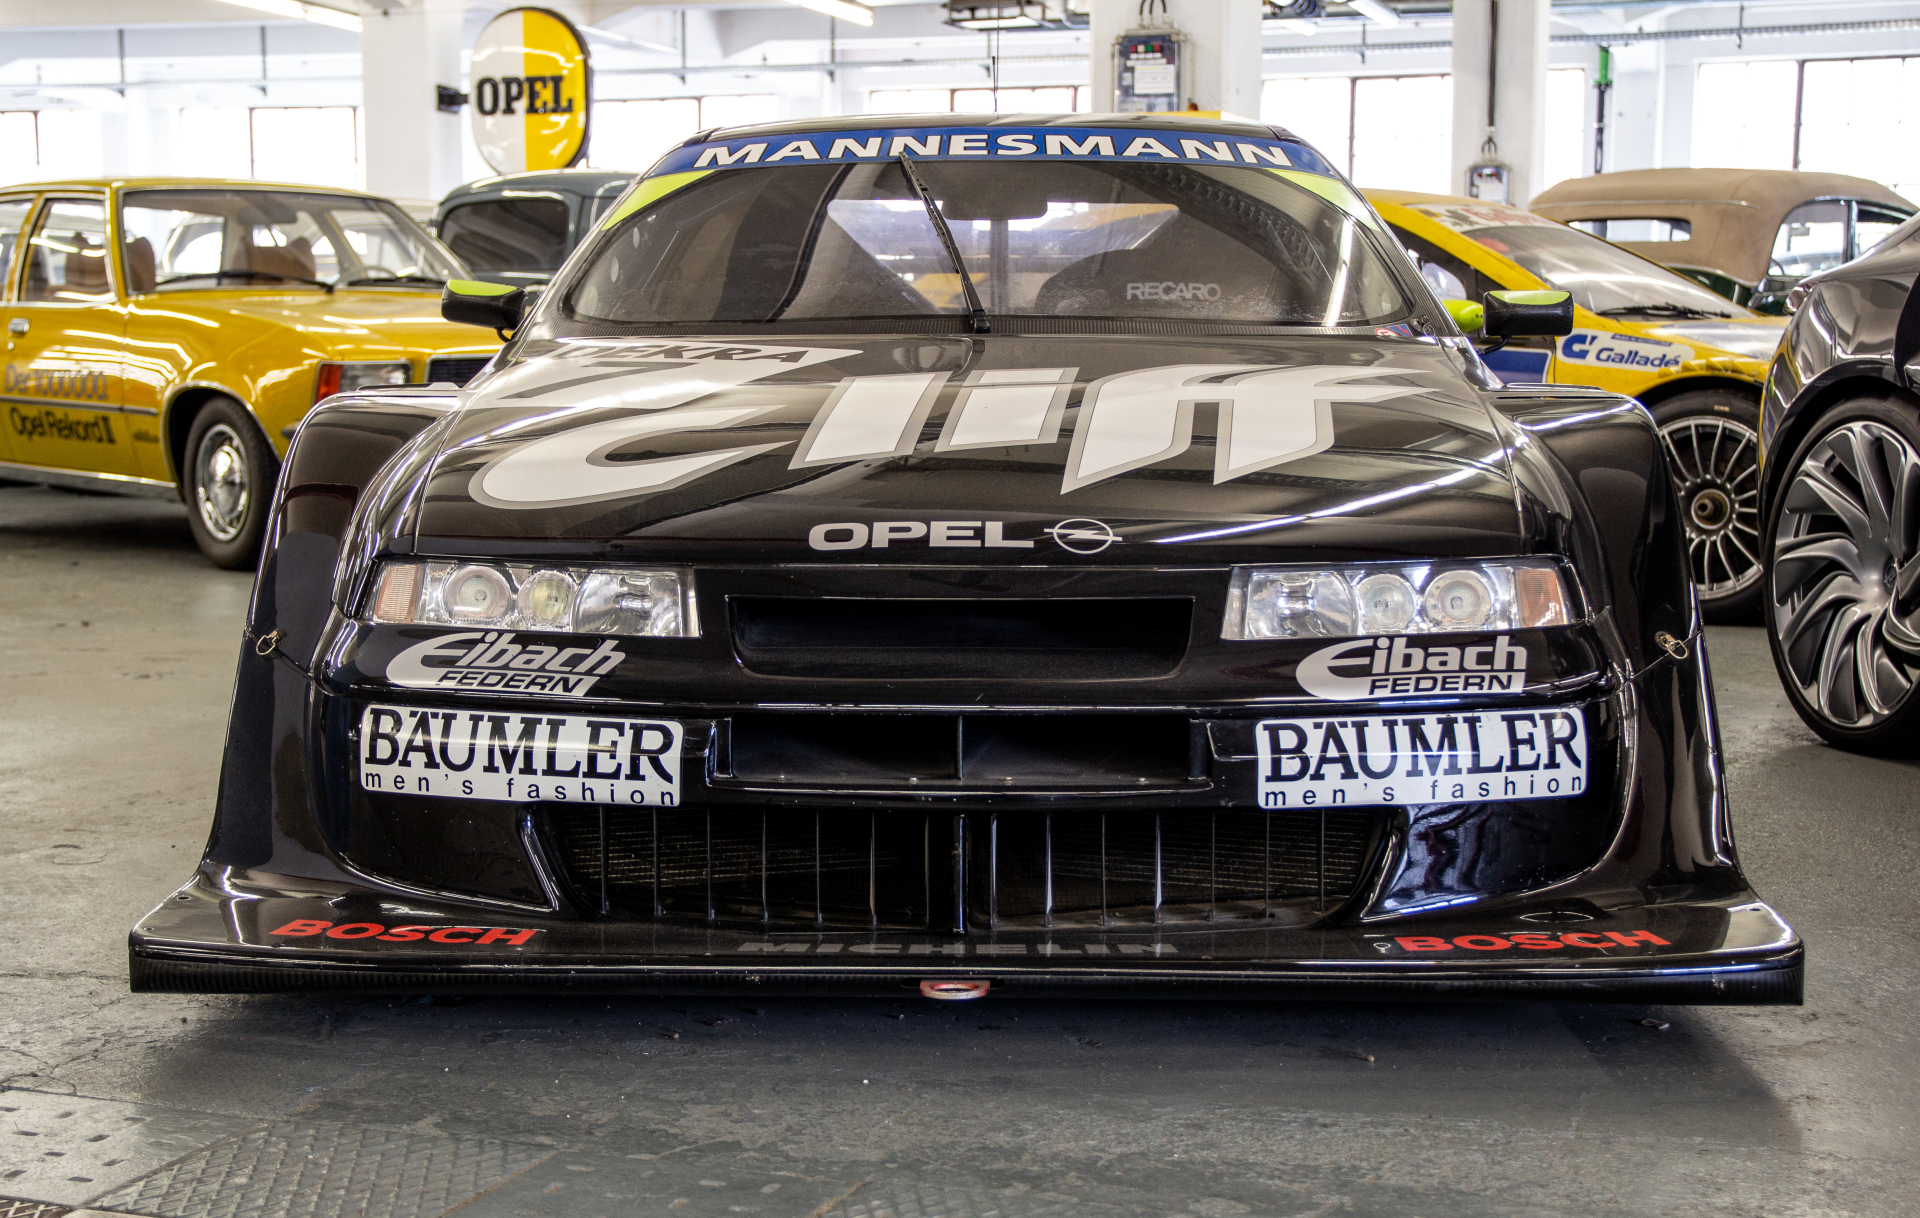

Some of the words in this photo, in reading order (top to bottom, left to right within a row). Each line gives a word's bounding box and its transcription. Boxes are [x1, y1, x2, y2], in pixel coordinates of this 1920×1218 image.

[477, 75, 573, 115] OPEL
[691, 133, 1293, 168] MANNESMANN
[1126, 281, 1222, 302] RECARO
[558, 343, 809, 363] DEKRA
[1595, 347, 1681, 368] Galladé
[9, 407, 46, 441] Opel
[44, 410, 104, 443] Rekord
[808, 521, 1035, 551] OPEL
[386, 631, 626, 683] Eibach
[1296, 635, 1528, 693] Eibach
[436, 670, 586, 693] FEDERN
[1368, 674, 1513, 696] FEDERN
[364, 707, 675, 785] BÄUMLER
[1262, 711, 1582, 783] BÄUMLER
[365, 771, 474, 796] men's
[506, 777, 675, 806] fashion
[1264, 781, 1395, 807] men's
[1430, 774, 1582, 800] fashion
[269, 919, 537, 946] BOSCH
[1394, 930, 1672, 952] BOSCH
[737, 942, 1179, 955] MICHELIN
